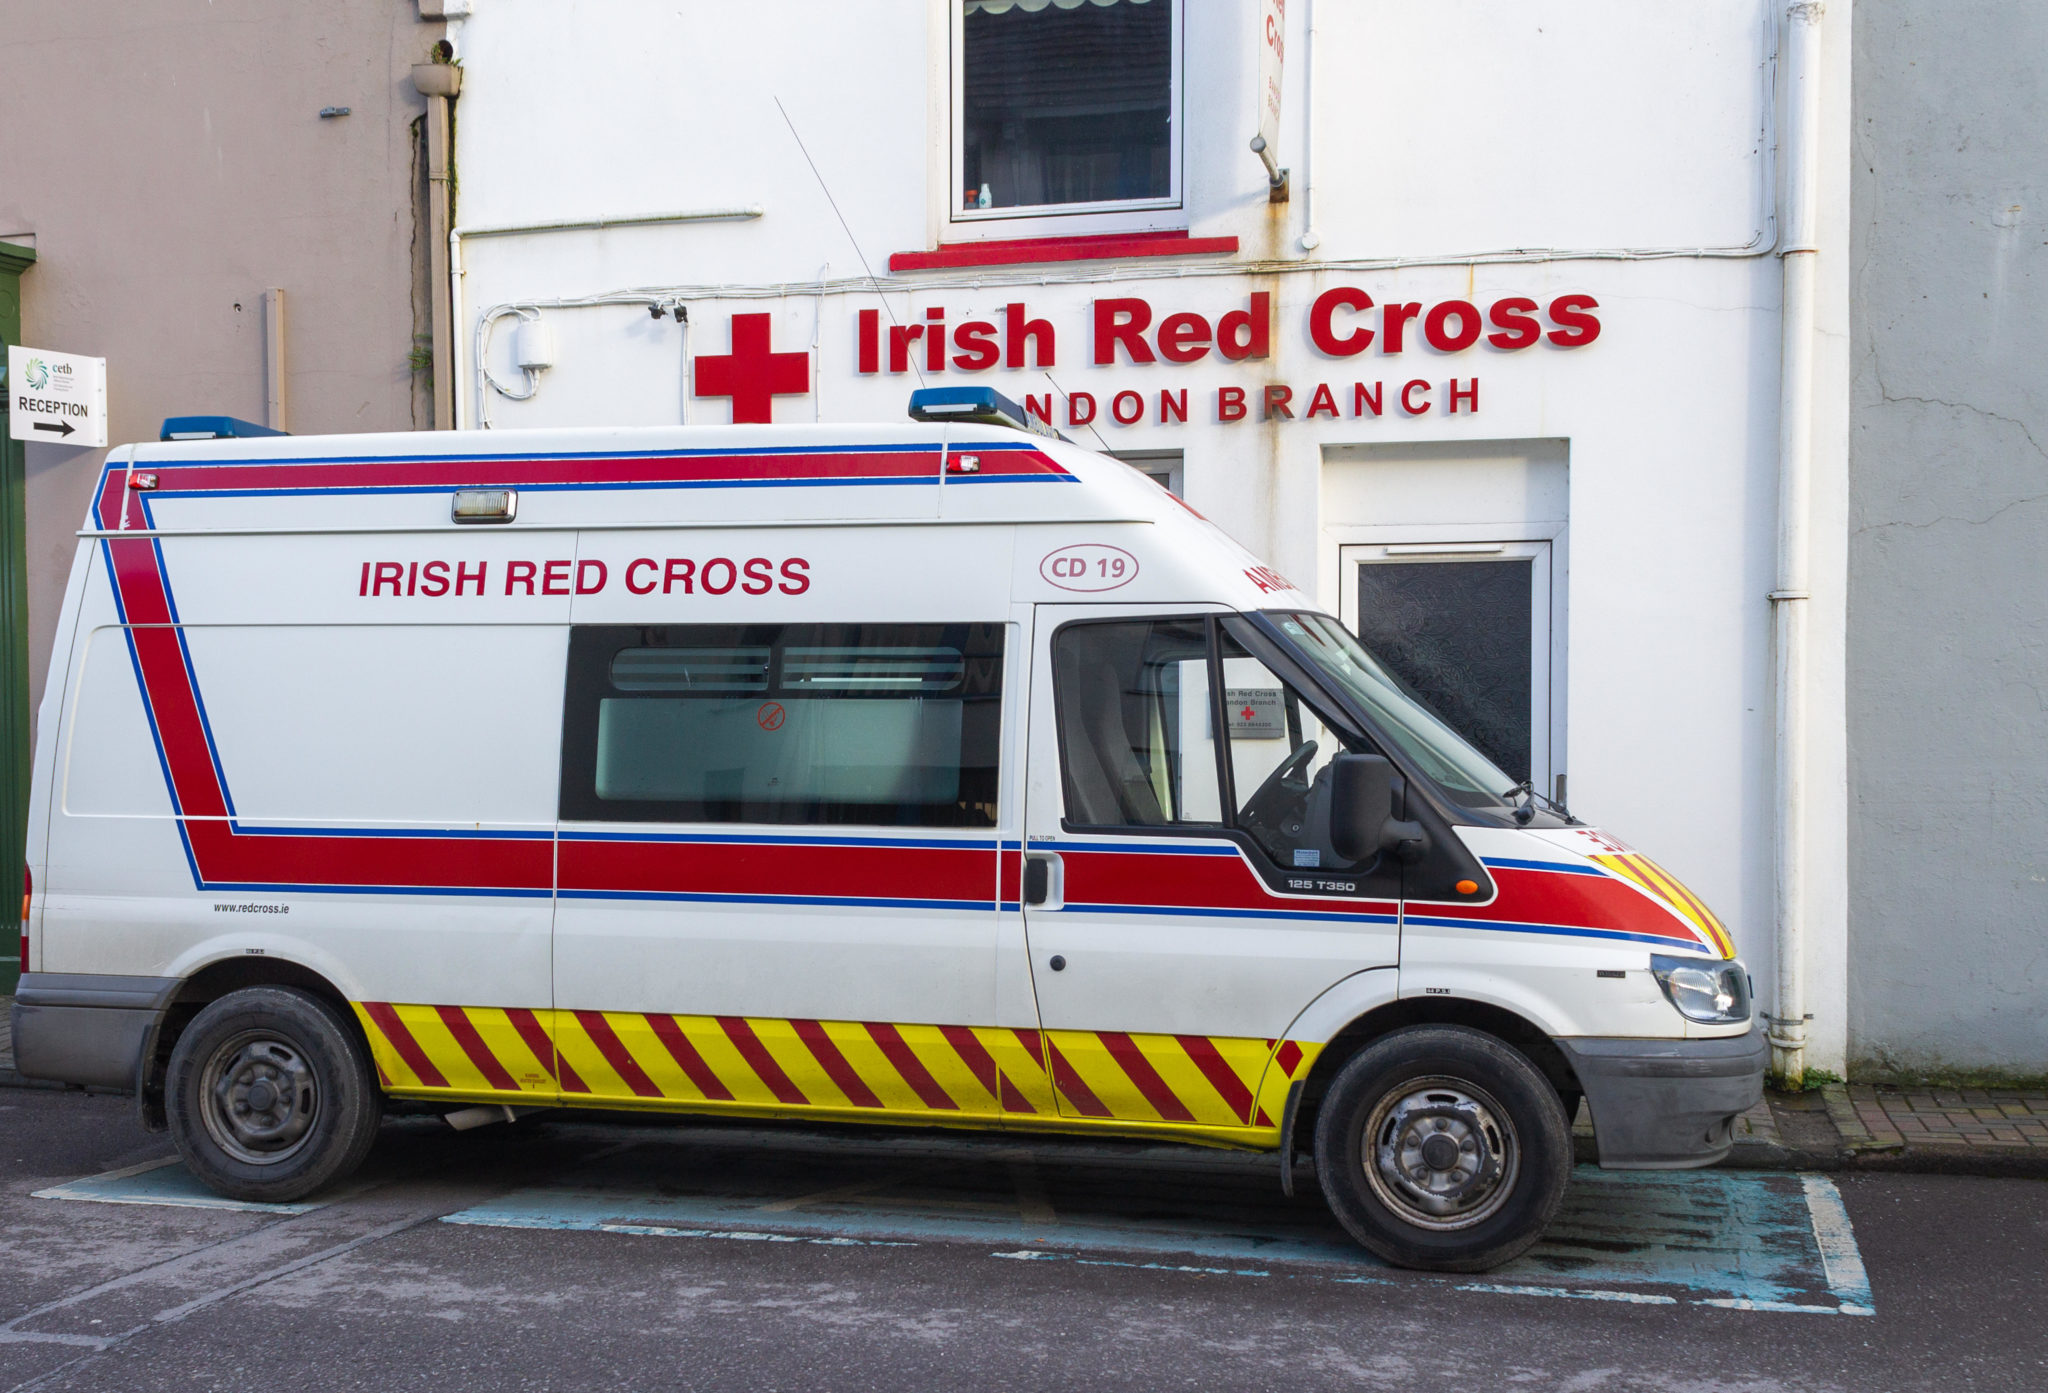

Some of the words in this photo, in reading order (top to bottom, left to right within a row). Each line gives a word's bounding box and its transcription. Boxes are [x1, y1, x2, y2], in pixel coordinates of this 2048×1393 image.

[858, 302, 1056, 373] Irish
[1093, 291, 1271, 365] Red
[1309, 286, 1601, 357] Cross
[19, 396, 88, 417] RECEPTION
[1025, 388, 1188, 426] NDON
[1218, 377, 1479, 421] BRANCH
[359, 561, 487, 597] IRISH
[504, 559, 608, 596] RED
[625, 557, 810, 595] CROSS
[1051, 557, 1087, 577] CD
[1097, 557, 1125, 578] 19
[1288, 880, 1312, 889] 125
[1317, 881, 1355, 891] T350
[214, 902, 290, 914] www.redcross.ie
